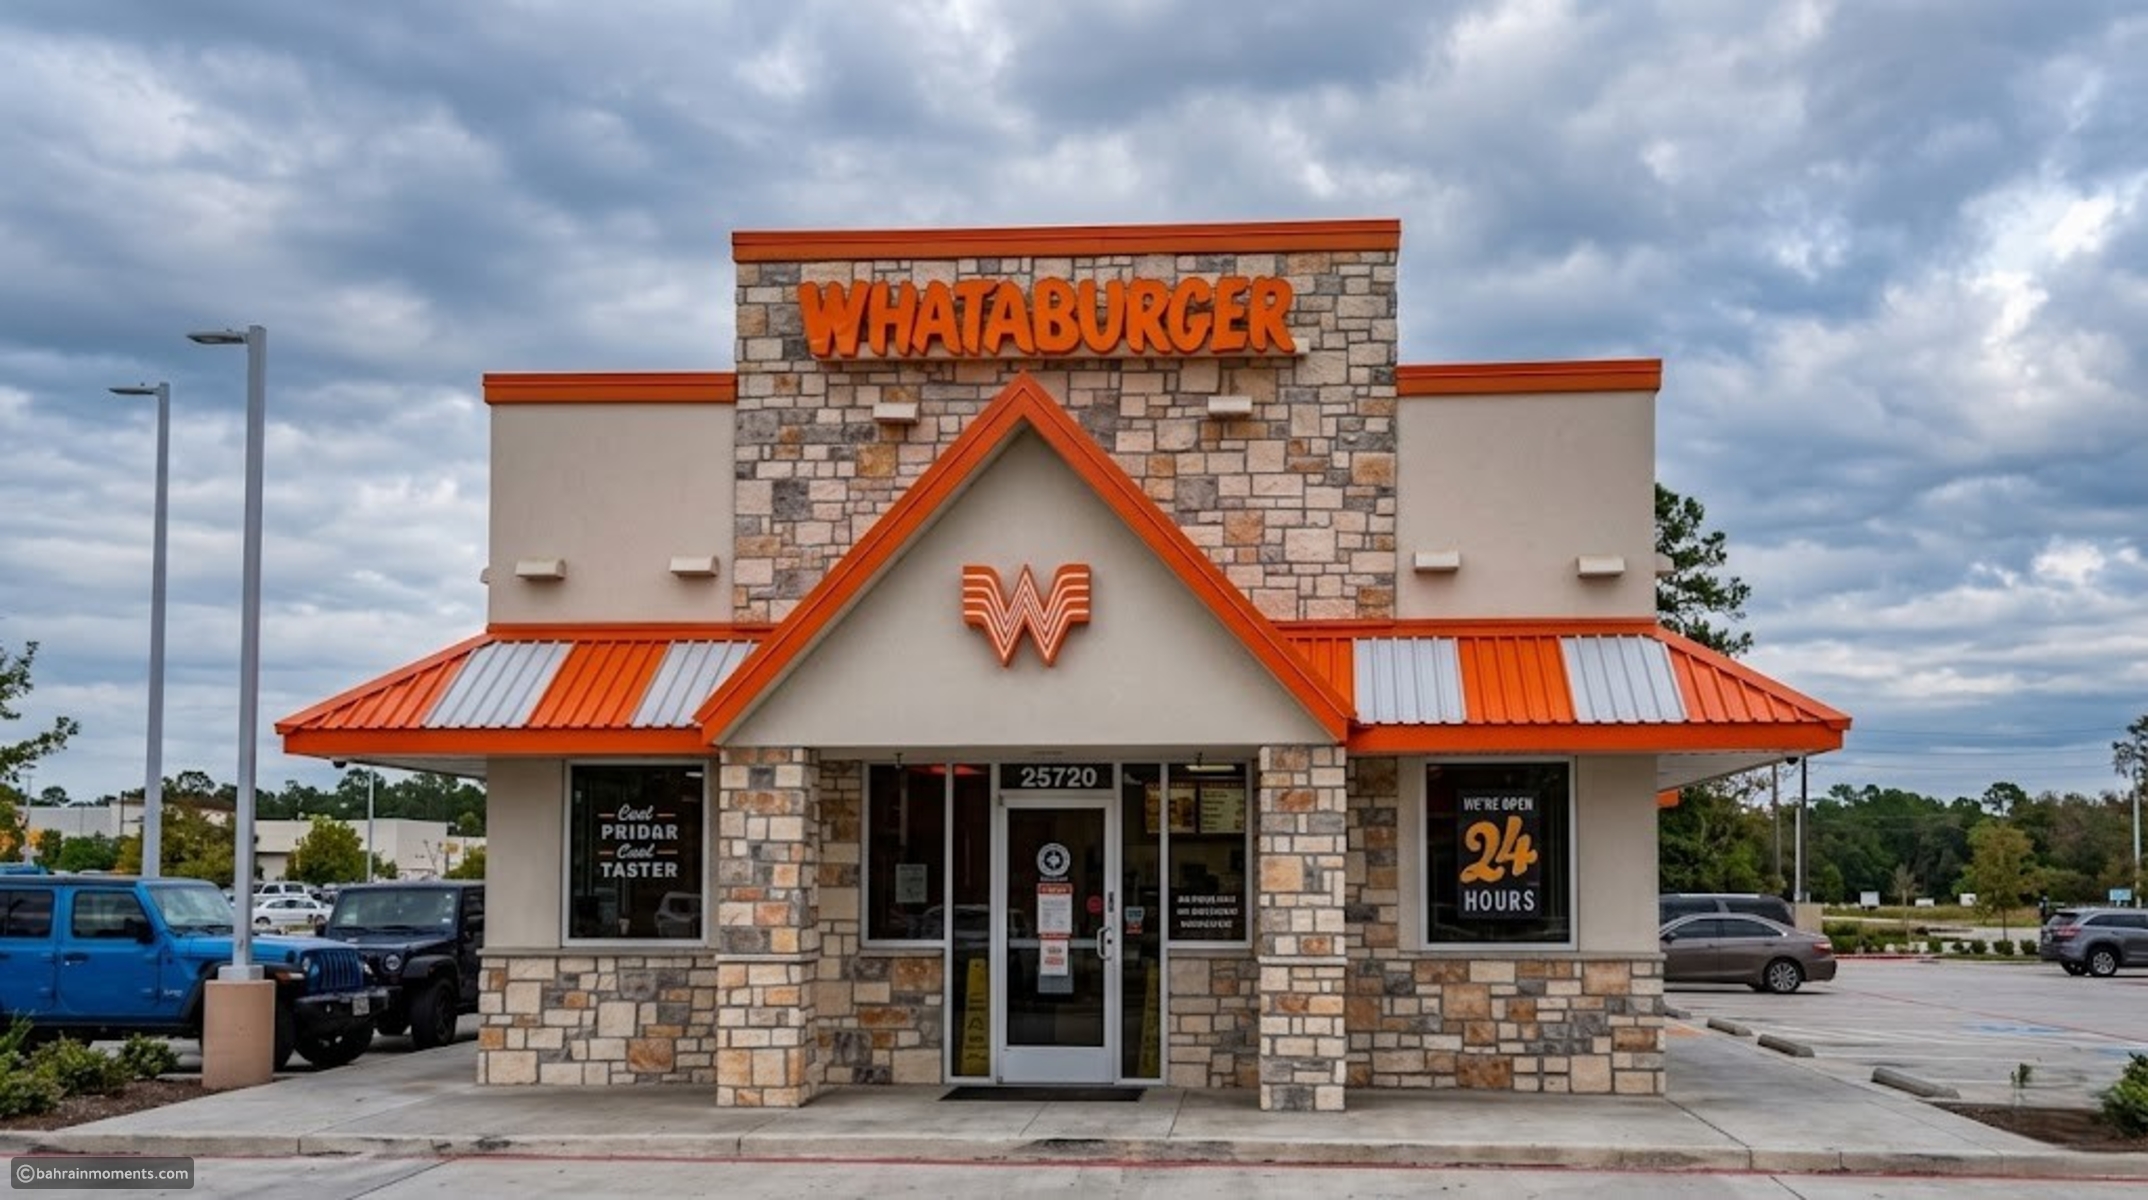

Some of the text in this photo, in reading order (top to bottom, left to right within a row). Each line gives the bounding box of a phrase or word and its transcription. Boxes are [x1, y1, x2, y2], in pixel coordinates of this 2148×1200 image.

[798, 276, 1296, 357] WHATABURGER
[962, 563, 1091, 668] W
[1021, 767, 1097, 788] 25720
[1463, 797, 1534, 811] WE'RE OPEN
[601, 824, 678, 840] PRIDAR
[1460, 815, 1538, 883] 24
[600, 862, 678, 878] TASTER
[1464, 890, 1535, 911] HOURS
